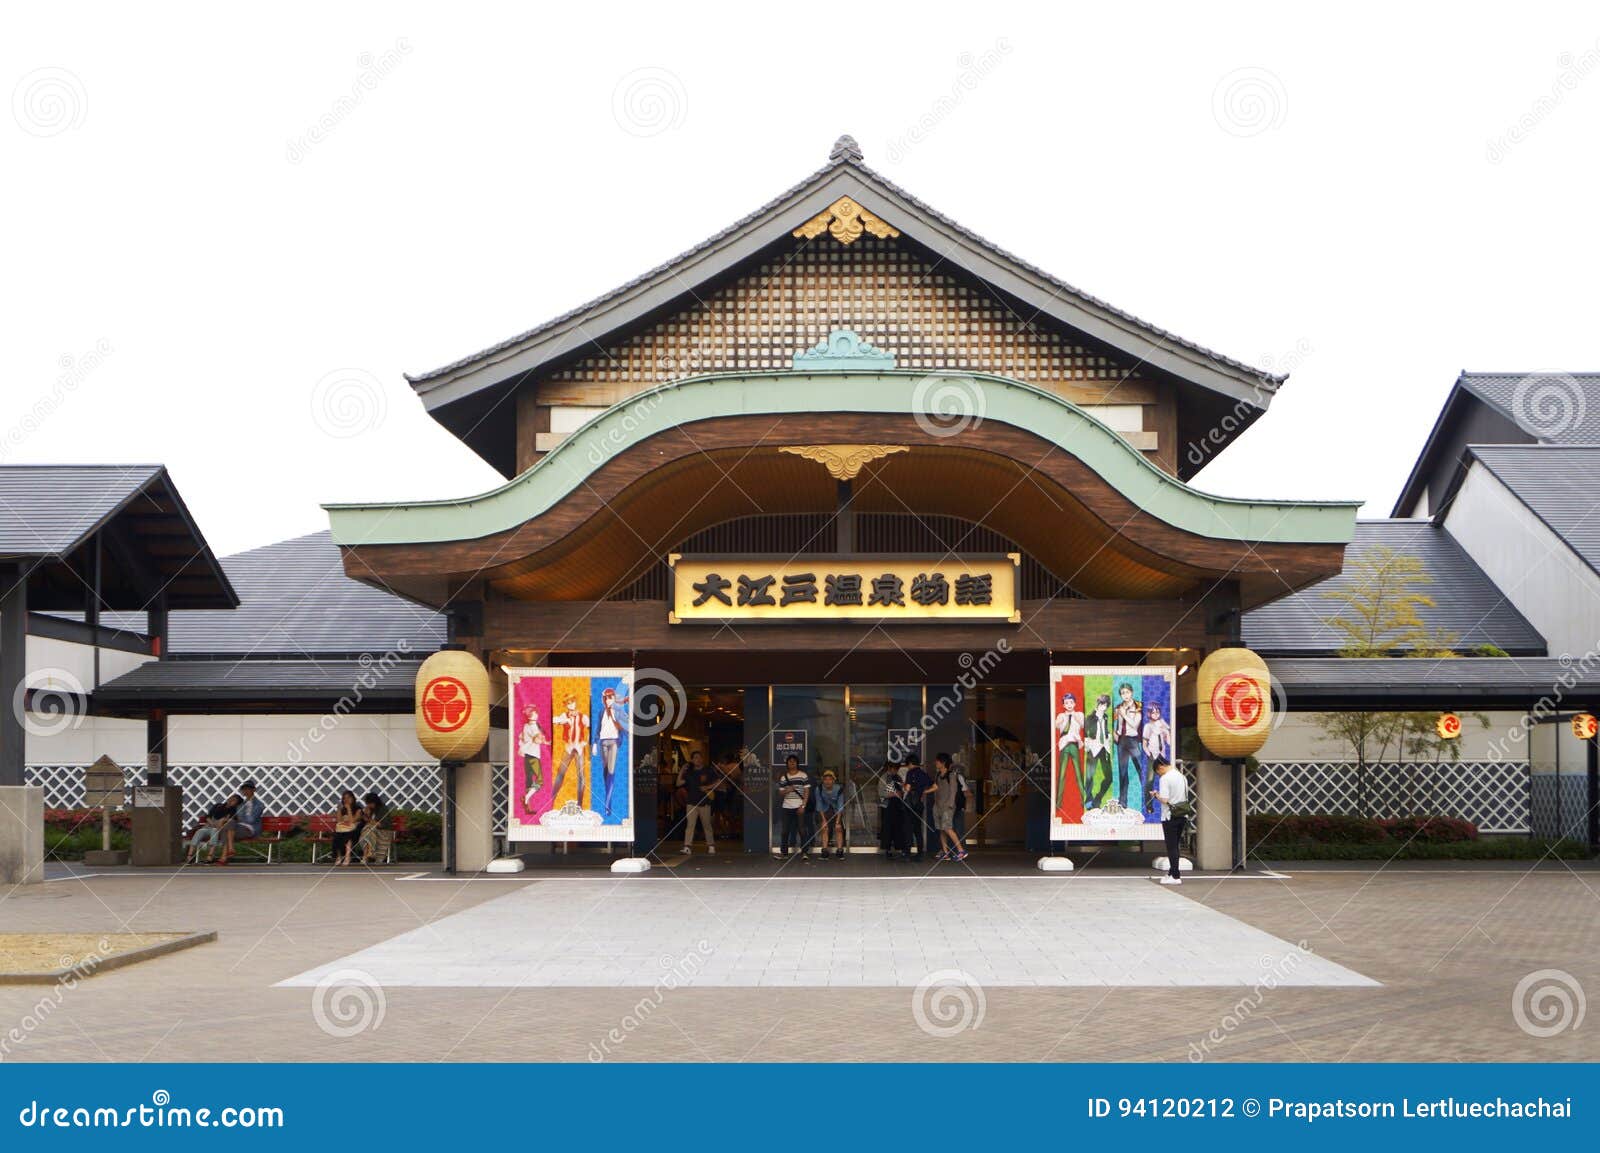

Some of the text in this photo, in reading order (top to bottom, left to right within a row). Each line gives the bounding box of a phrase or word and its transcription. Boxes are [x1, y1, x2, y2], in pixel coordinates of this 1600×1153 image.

[692, 573, 992, 607] 大江戸温泉物語
